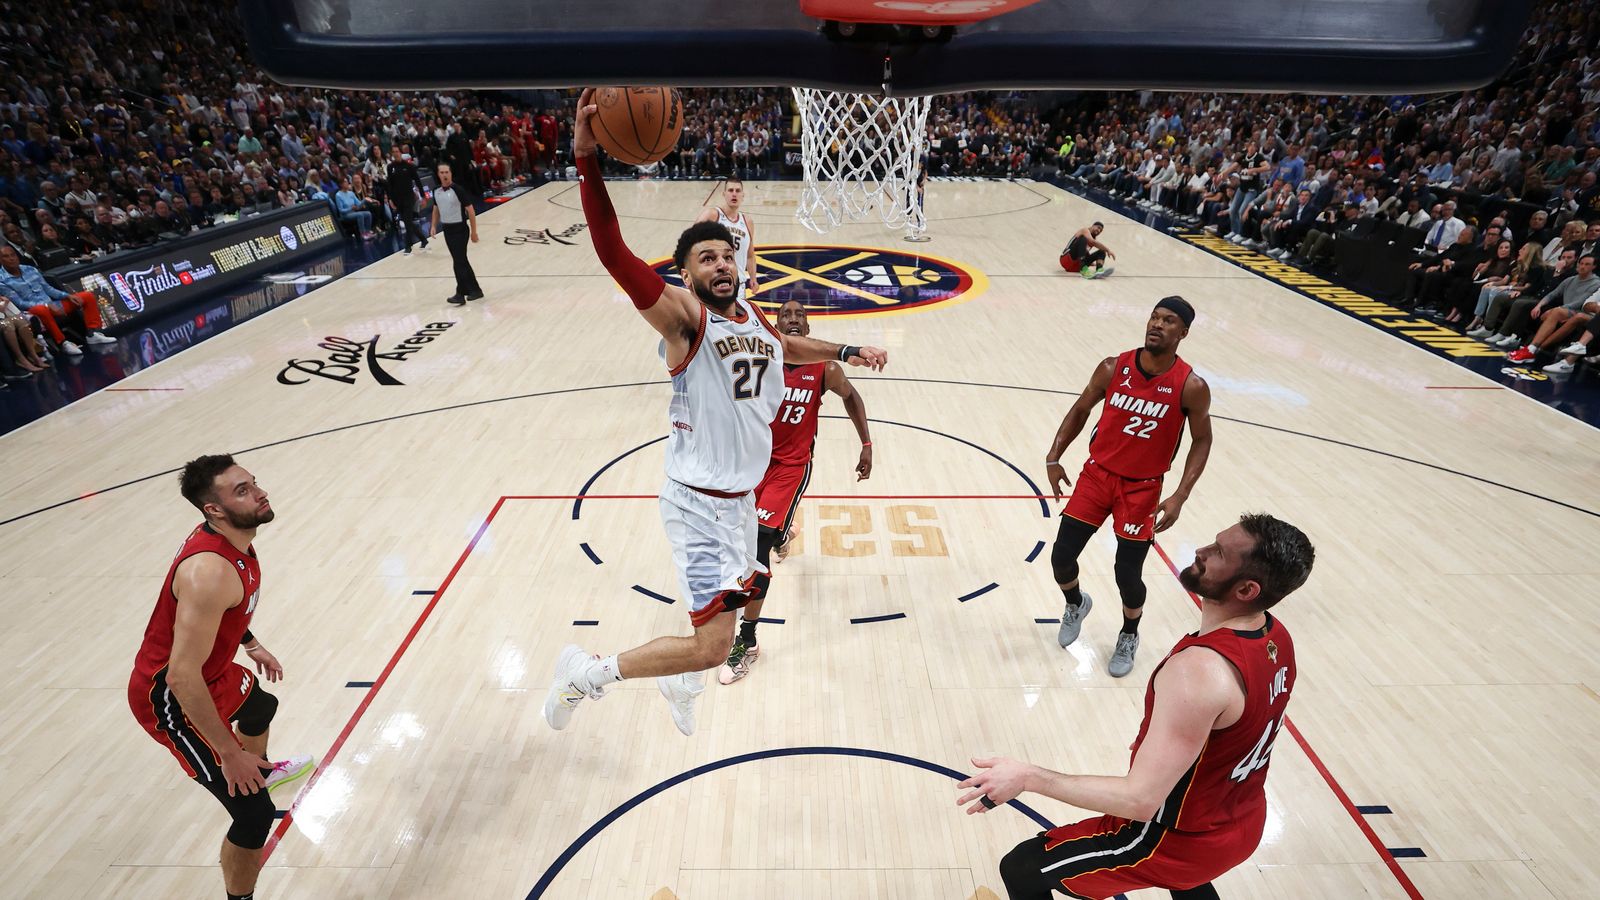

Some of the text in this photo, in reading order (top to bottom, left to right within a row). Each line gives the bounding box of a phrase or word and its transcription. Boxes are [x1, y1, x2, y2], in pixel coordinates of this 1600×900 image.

[295, 215, 337, 245] IF NECESSARY
[210, 240, 256, 273] THURSDAY
[125, 263, 181, 312] Finals
[1297, 286, 1410, 316] HIGH
[713, 335, 777, 360] DENVER
[1370, 318, 1507, 357] MILE
[276, 321, 457, 386] Ball Arena
[732, 357, 770, 401] 27
[1157, 385, 1173, 394] UKG
[783, 386, 814, 404] AMI
[1109, 391, 1170, 419] MIAMI
[781, 404, 806, 425] 13
[1122, 415, 1159, 440] 22
[1269, 666, 1289, 706] LOVE
